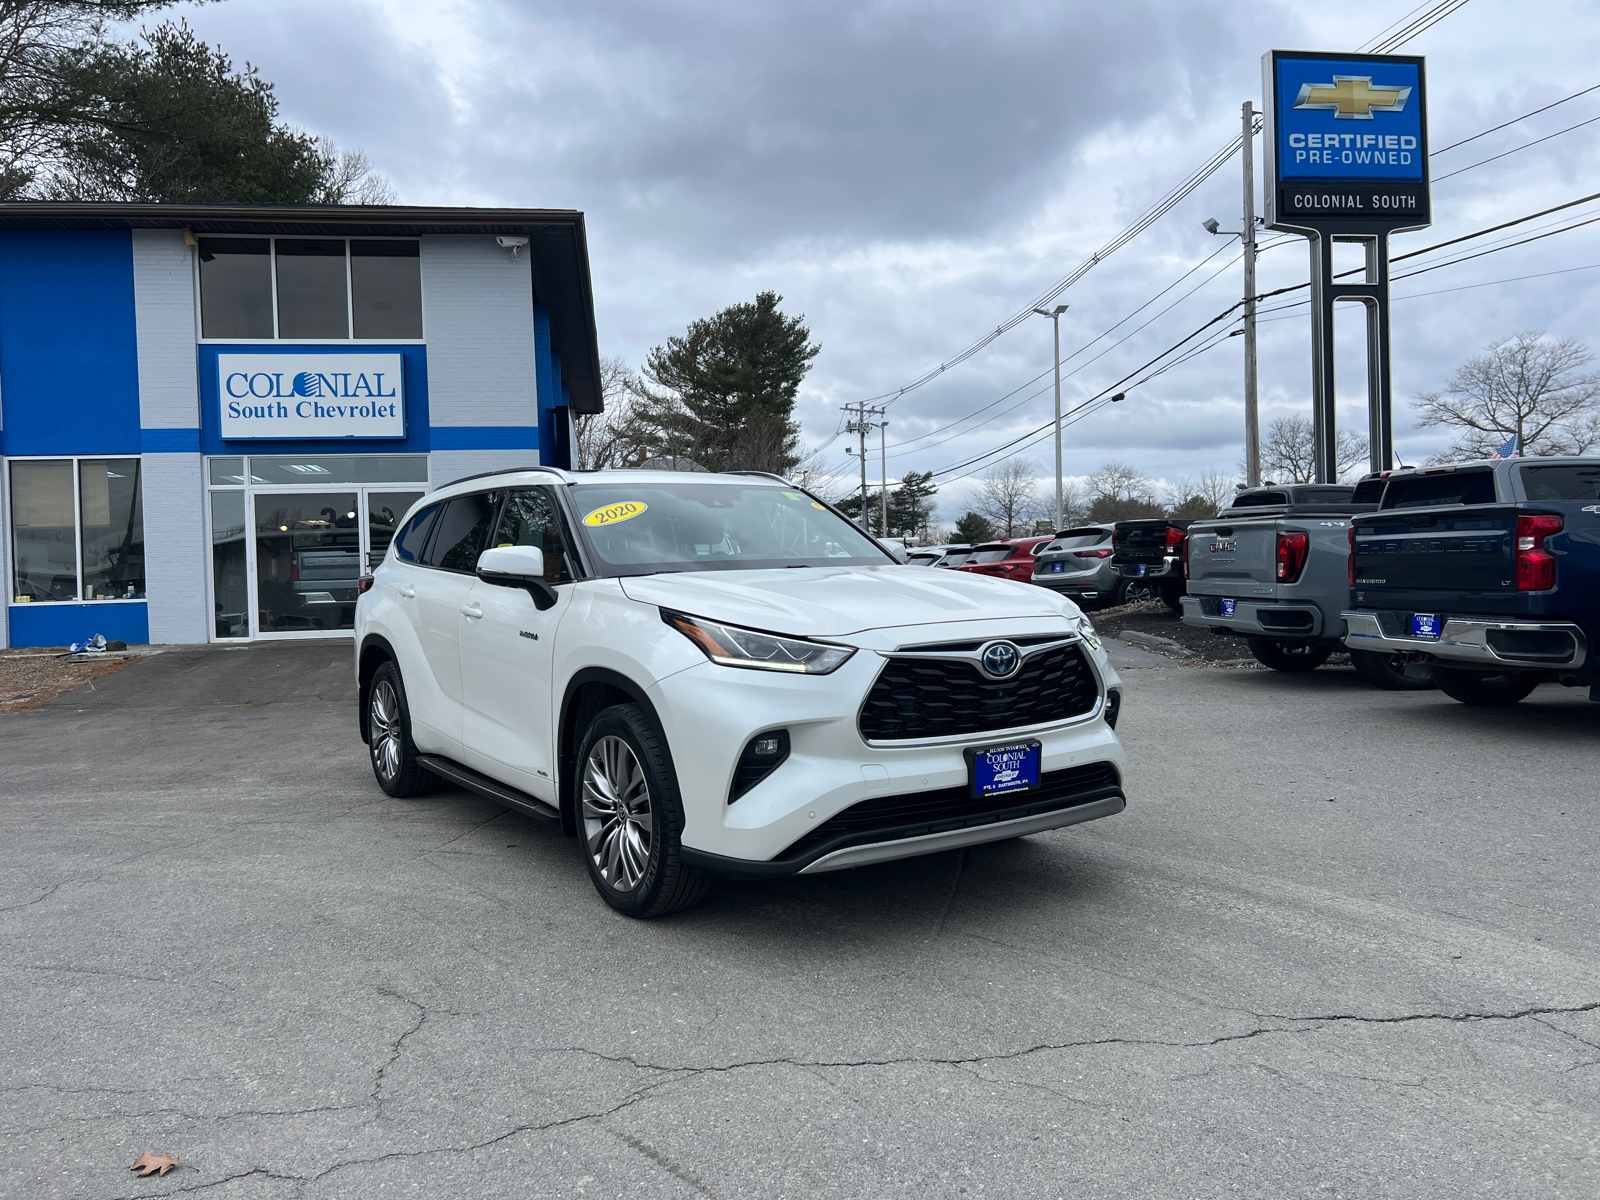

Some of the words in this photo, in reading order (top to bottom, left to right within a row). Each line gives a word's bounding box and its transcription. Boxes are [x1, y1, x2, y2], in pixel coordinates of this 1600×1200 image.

[1289, 133, 1417, 149] CERTIFIED
[1296, 150, 1412, 165] PRE-OWNED
[1294, 194, 1363, 208] COLONIAL
[1372, 195, 1416, 209] SOUTH
[226, 371, 396, 398] COLONIAL
[228, 401, 288, 419] South
[296, 401, 396, 419] Chevrolet
[595, 503, 637, 524] 2020
[1210, 542, 1237, 553] GMC
[987, 751, 1026, 764] COLONIAL
[993, 760, 1020, 772] SOUTH
